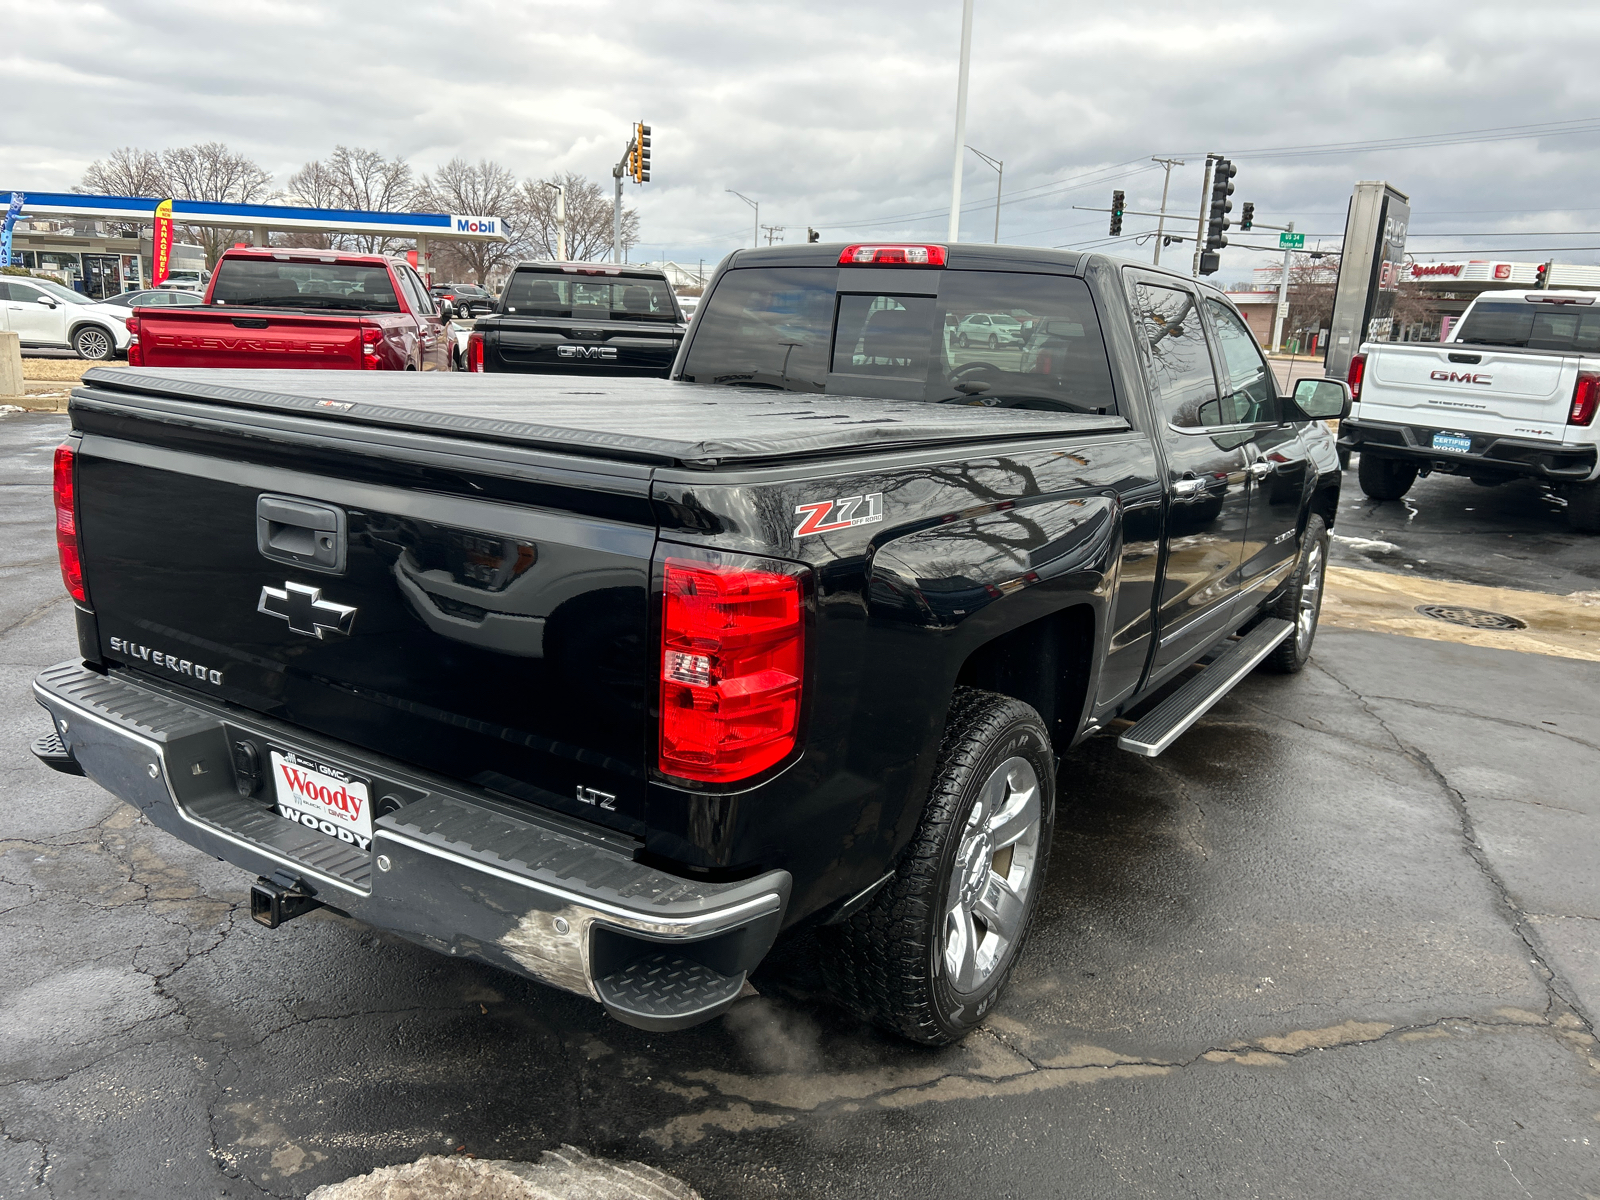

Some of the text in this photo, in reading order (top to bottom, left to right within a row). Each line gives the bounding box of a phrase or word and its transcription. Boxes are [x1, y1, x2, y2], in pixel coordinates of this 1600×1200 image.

[457, 219, 495, 233] Mobil
[159, 219, 168, 279] MANAGEMENT
[1411, 263, 1464, 277] Speedway
[155, 336, 347, 354] CHEVROLET
[557, 345, 618, 360] GMC
[1430, 370, 1494, 385] GMC
[1432, 444, 1469, 453] WOODY
[1433, 437, 1471, 447] CERTIFIED
[793, 492, 883, 538] Z71
[851, 517, 864, 526] OFF
[110, 636, 224, 686] SILVERADO
[319, 764, 346, 781] GMC
[281, 763, 364, 821] Woody
[576, 785, 617, 811] LTZ
[327, 808, 349, 821] GMC
[278, 804, 372, 850] WOODY
